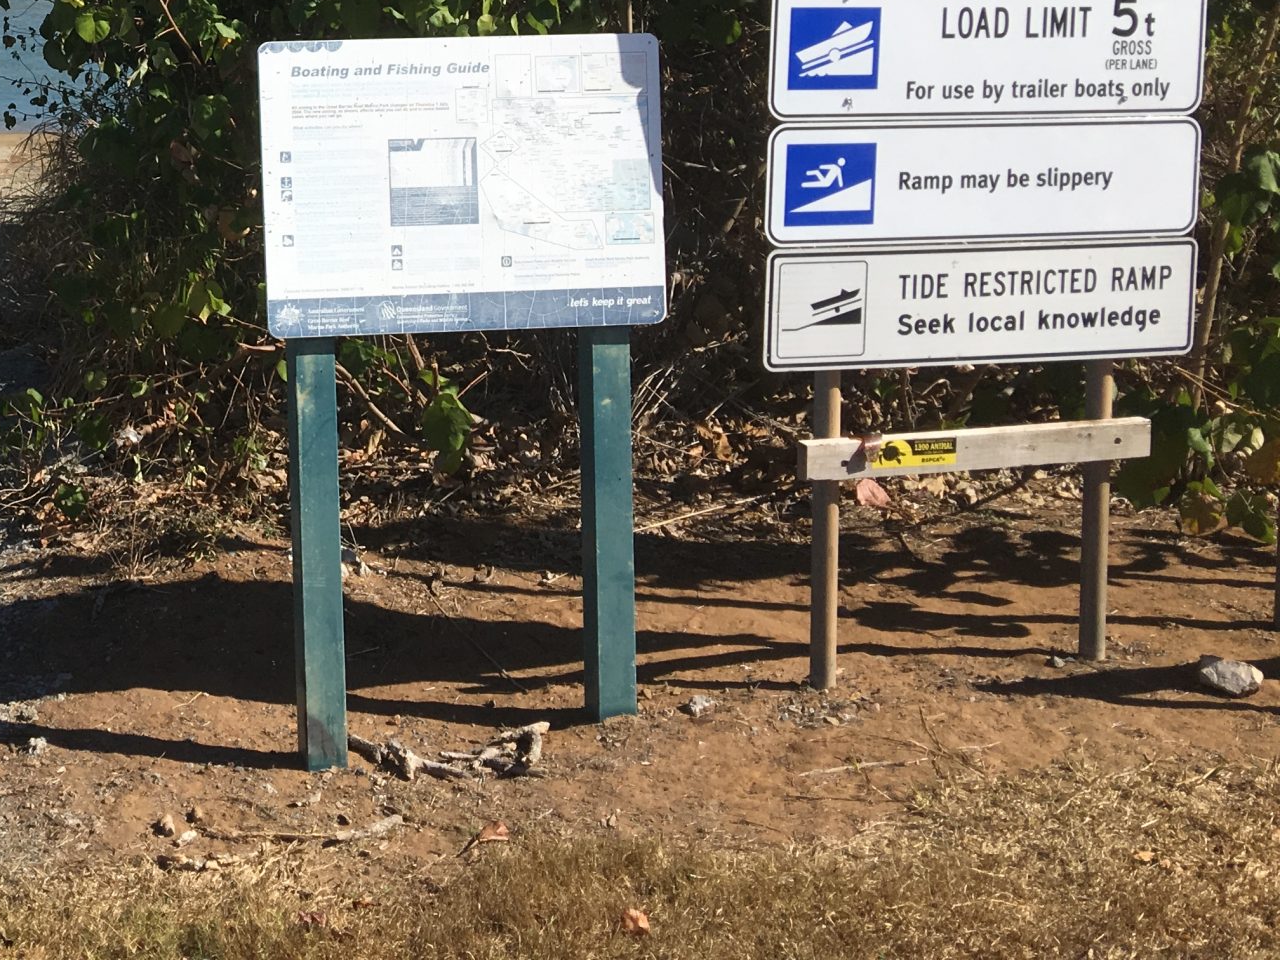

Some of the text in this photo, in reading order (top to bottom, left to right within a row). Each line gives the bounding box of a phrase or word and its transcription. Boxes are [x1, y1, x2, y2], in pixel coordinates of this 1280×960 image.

[941, 7, 1009, 39] LOAD
[1026, 7, 1092, 38] LIMIT
[1113, 40, 1152, 55] GROSS
[291, 63, 490, 79] Boating and Fishing Guide
[1105, 59, 1157, 70] (PER LANE)
[906, 78, 1170, 101] For use by trailer boats only
[899, 169, 1113, 194] Ramp may be slippery
[899, 266, 1172, 299] TIDE RESTRICTED RAMP
[592, 298, 614, 307] keep
[617, 296, 623, 305] it
[626, 296, 652, 306] great
[897, 307, 1161, 336] Seek local knowledge
